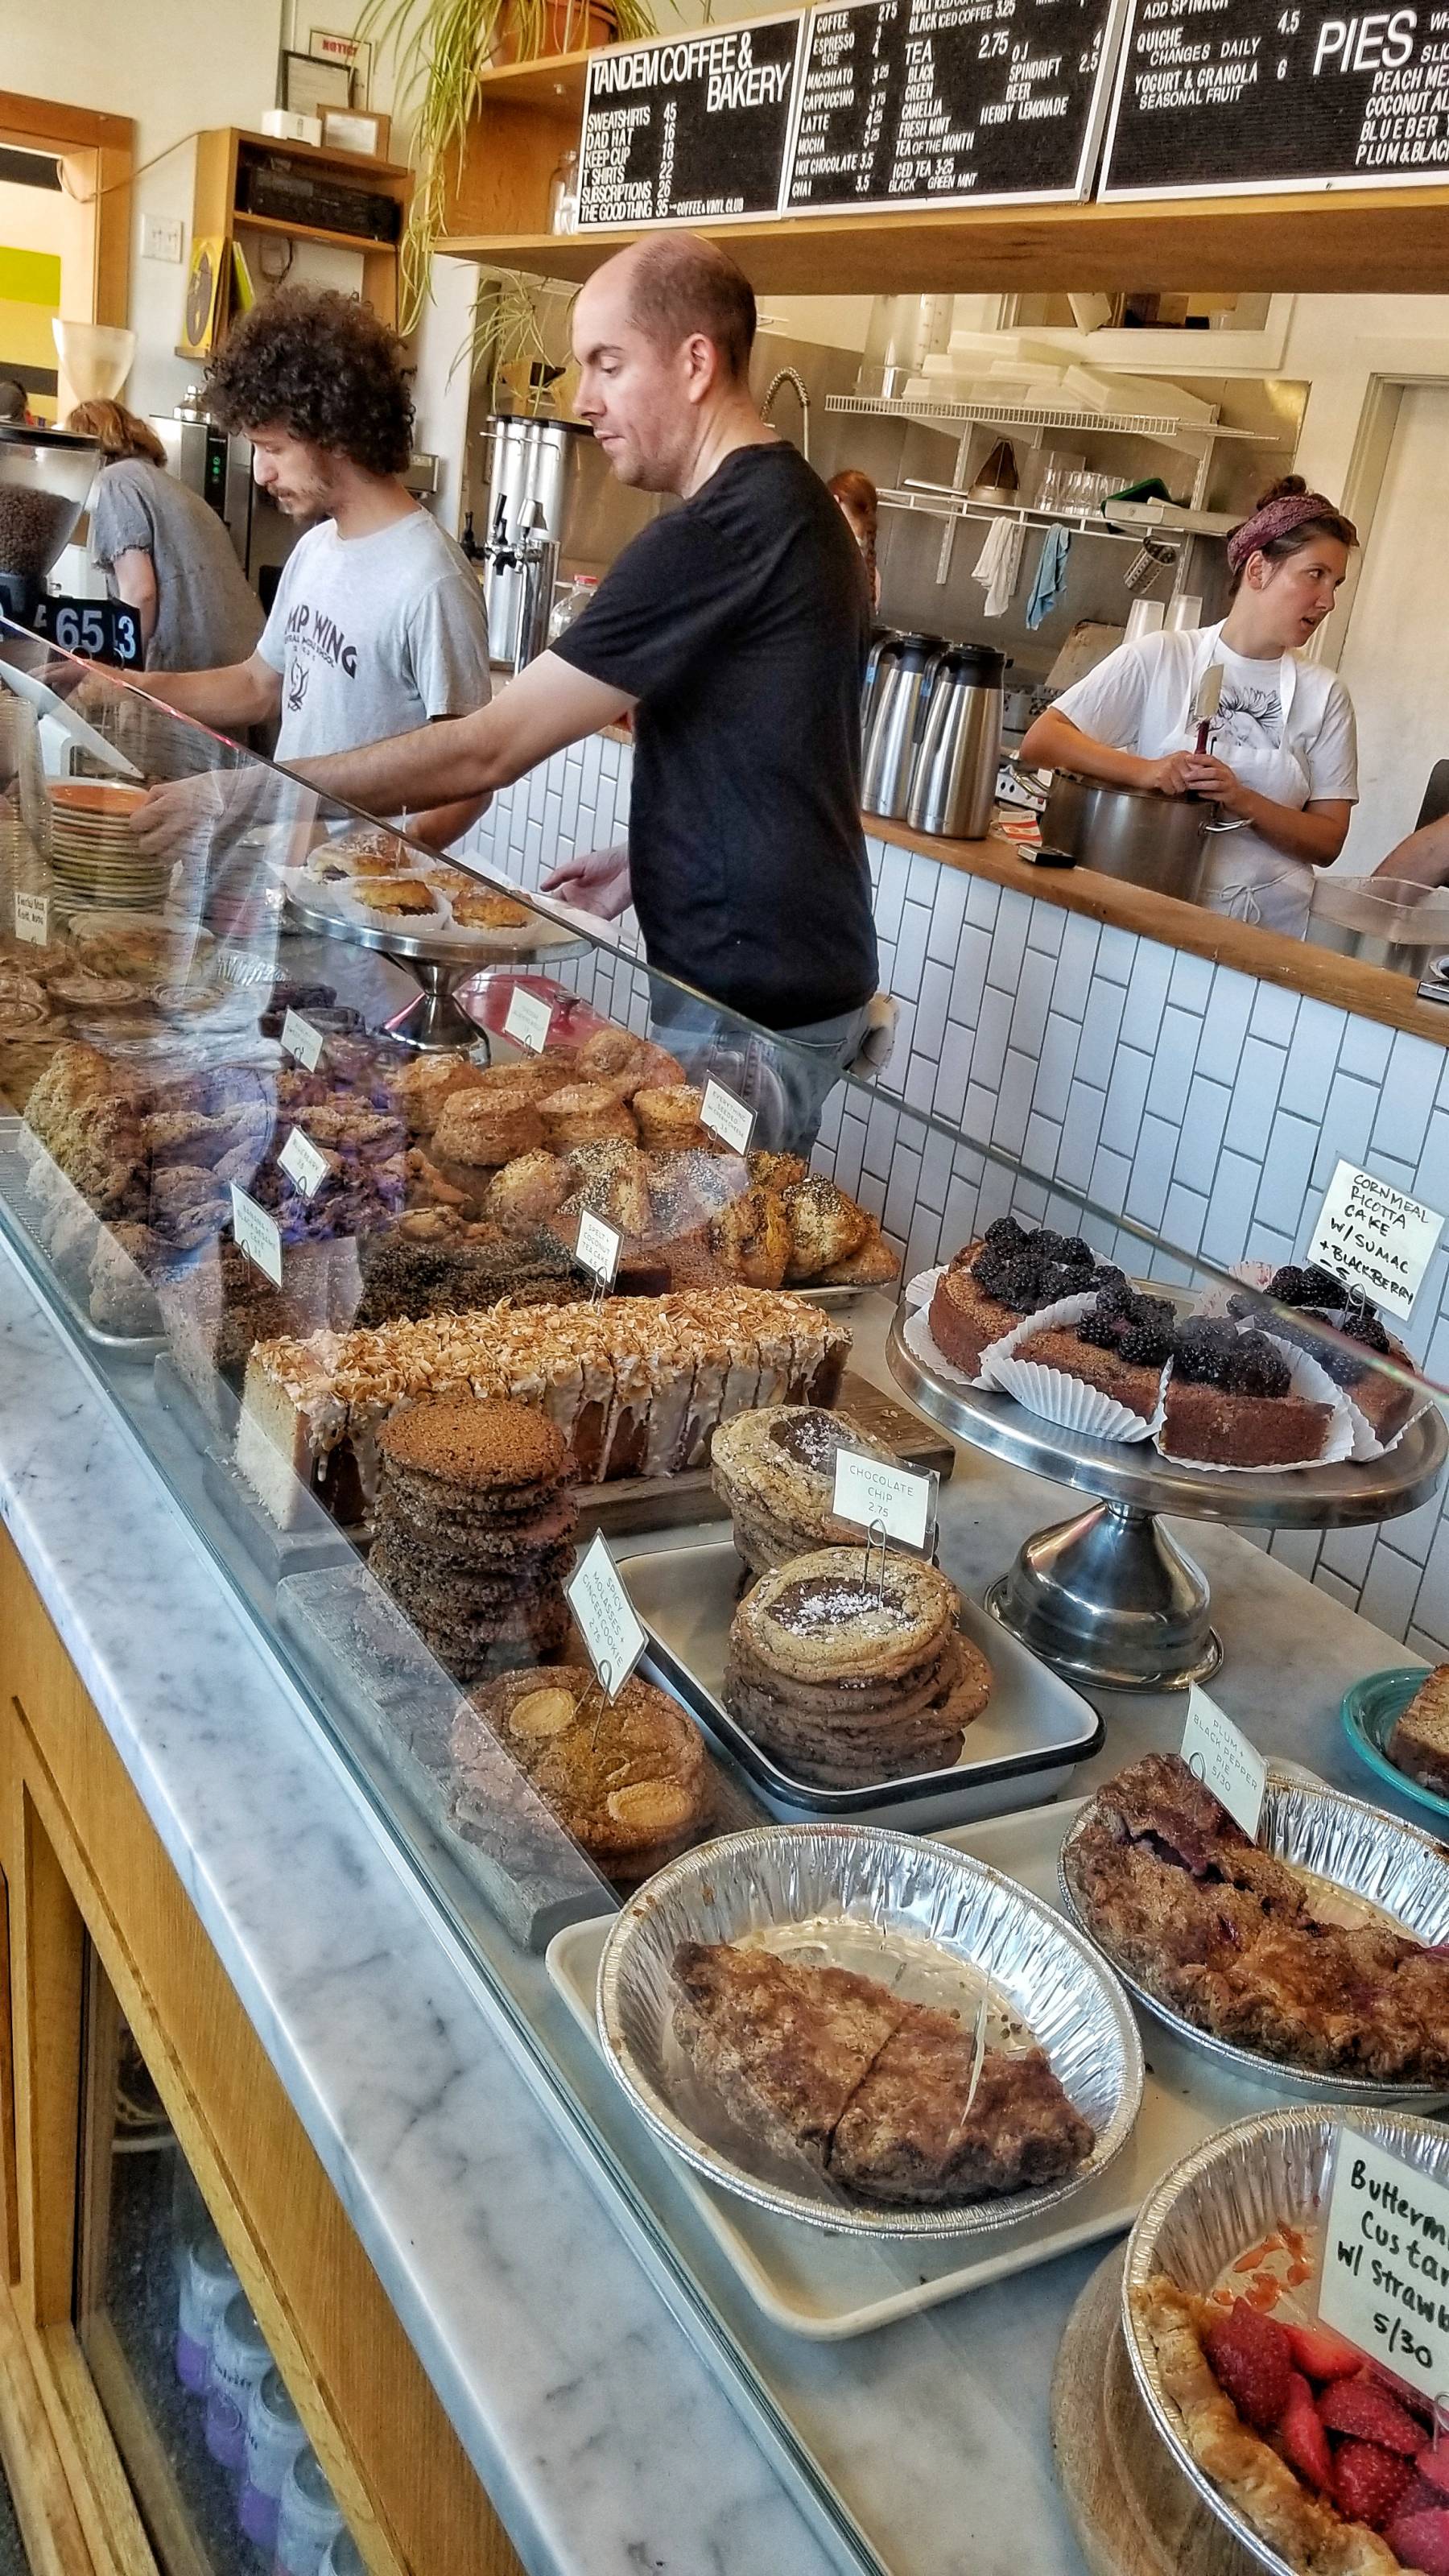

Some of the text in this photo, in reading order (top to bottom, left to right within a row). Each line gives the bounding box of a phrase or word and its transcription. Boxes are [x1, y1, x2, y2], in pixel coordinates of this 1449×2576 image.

[816, 11, 849, 34] COFFEE
[909, 12, 937, 35] BLACK
[938, 11, 957, 28] ICED
[958, 4, 993, 26] COFFEE
[1143, 2, 1167, 20] ADD
[813, 25, 881, 56] ESPRESSO 3
[1093, 29, 1103, 50] 4
[1137, 10, 1300, 53] QUICHE 4.5
[1312, 10, 1418, 76] PIES
[872, 39, 879, 58] 4
[905, 31, 1009, 65] TEA 2.75
[1150, 36, 1261, 66] CHANGES DAILY
[592, 31, 753, 95] TANDEM COFFEE &
[908, 64, 935, 84] BLACK
[1009, 52, 1100, 82] SPINDRIFT 2.5
[1135, 59, 1288, 95] YOGURT & GRANOLA 6
[707, 62, 791, 112] BAKERY
[807, 68, 853, 90] MACCHIATO
[905, 81, 934, 101] GREEN
[1006, 82, 1031, 102] BEER
[1372, 67, 1423, 93] PEACH
[803, 89, 854, 112] CAPPUCCINO
[902, 97, 942, 120] CAMELLIA
[980, 96, 1069, 126] HERBY LEMONADE
[1139, 85, 1243, 110] SEASONAL FRUIT
[1365, 90, 1432, 119] COCONUT
[588, 102, 677, 132] SWEATSHIRTS 45
[801, 114, 830, 133] LATTE
[899, 116, 952, 138] FRESH MINT
[586, 122, 676, 151] DAD HAT 16
[798, 136, 825, 155] MOCHA
[895, 131, 975, 157] TEA OF THE MONTH
[584, 141, 675, 168] KEEP CUP 18
[795, 152, 874, 176] HOT CHOCOLATE 3.5
[592, 166, 625, 185] SHIRTS
[659, 160, 674, 180] 22
[889, 172, 978, 193] BLACK GREEN MINT
[892, 162, 913, 180] ICED
[914, 159, 931, 177] TEA
[582, 180, 671, 204] SUBSCRIPTIONS 26
[791, 174, 870, 199] CHAI 3.5
[581, 204, 599, 221] THE
[599, 201, 626, 221] GOOD
[626, 200, 652, 218] THING
[56, 608, 105, 653] 65
[118, 615, 136, 659] 3
[312, 610, 357, 679] WING
[1351, 1185, 1406, 1229] RICOTTA
[1353, 1174, 1429, 1223] CORNMEAL
[1344, 1204, 1390, 1237] CAKE
[584, 1232, 610, 1254] COCONUT
[1355, 1233, 1409, 1274] SUMAC
[1331, 1245, 1414, 1305] BLACKBERRY
[849, 1465, 914, 1496] CHOCOLATE
[868, 1487, 893, 1502] CHIP
[869, 1502, 889, 1517] 2.75
[593, 1571, 621, 1636] MOLASSES
[606, 1577, 623, 1612] SPICY
[582, 1574, 623, 1668] GINGER COOKIE
[1213, 1719, 1238, 1752] PLUM
[1193, 1714, 1257, 1791] BLACK PEPPER
[1216, 1755, 1230, 1776] PIE
